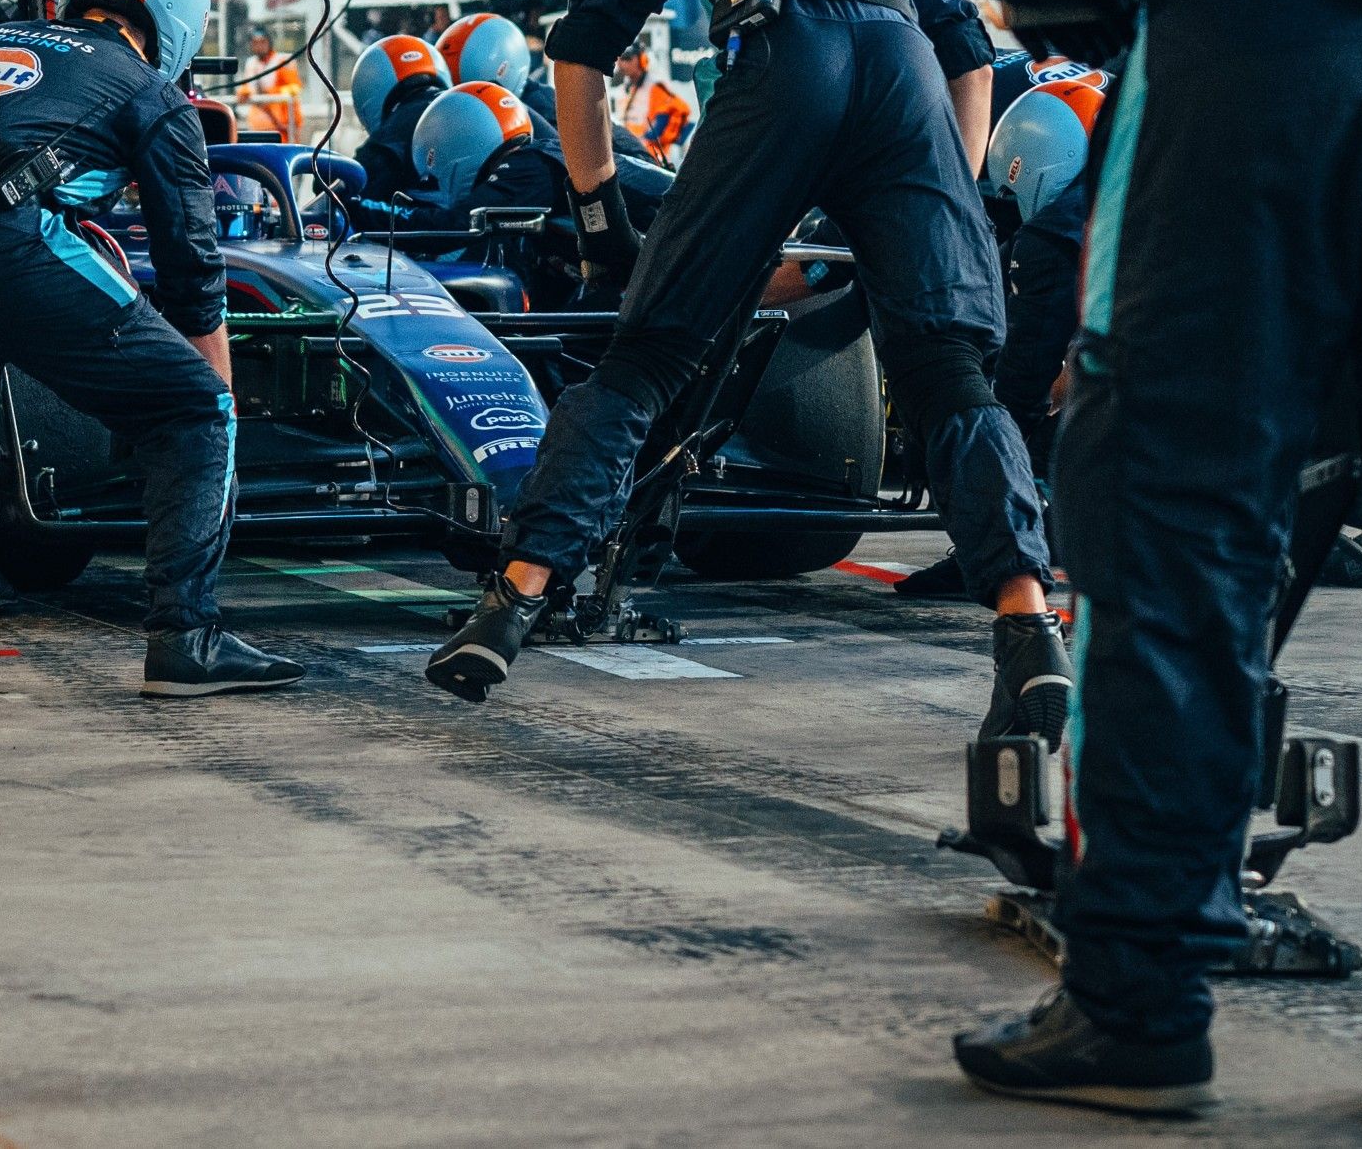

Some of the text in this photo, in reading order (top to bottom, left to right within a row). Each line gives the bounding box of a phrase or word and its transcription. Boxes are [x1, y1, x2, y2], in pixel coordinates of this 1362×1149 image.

[1038, 63, 1089, 83] Gul
[343, 293, 470, 319] 23
[426, 371, 525, 380] INGENUITY
[486, 413, 531, 426] pax8
[473, 437, 541, 464] PIRE
